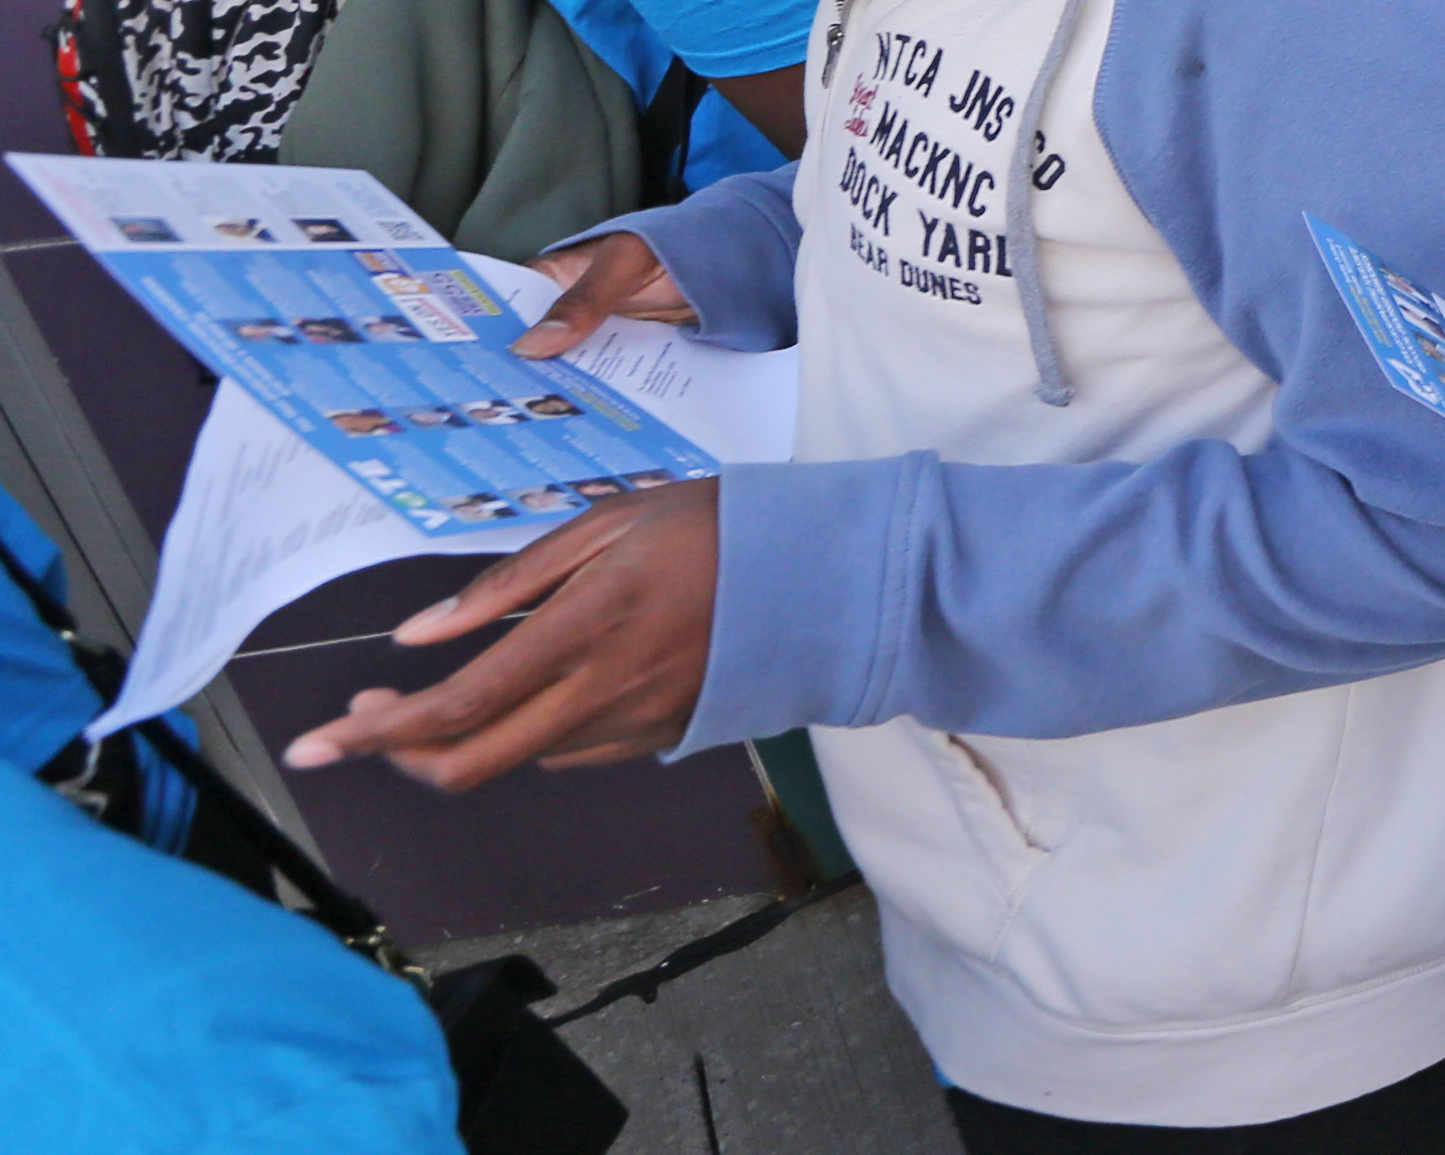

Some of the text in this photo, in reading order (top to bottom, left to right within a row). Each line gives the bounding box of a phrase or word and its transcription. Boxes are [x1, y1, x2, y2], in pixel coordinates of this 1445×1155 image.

[949, 68, 1015, 143] JNS
[839, 144, 899, 238] DOCK
[899, 258, 983, 306] DUNES
